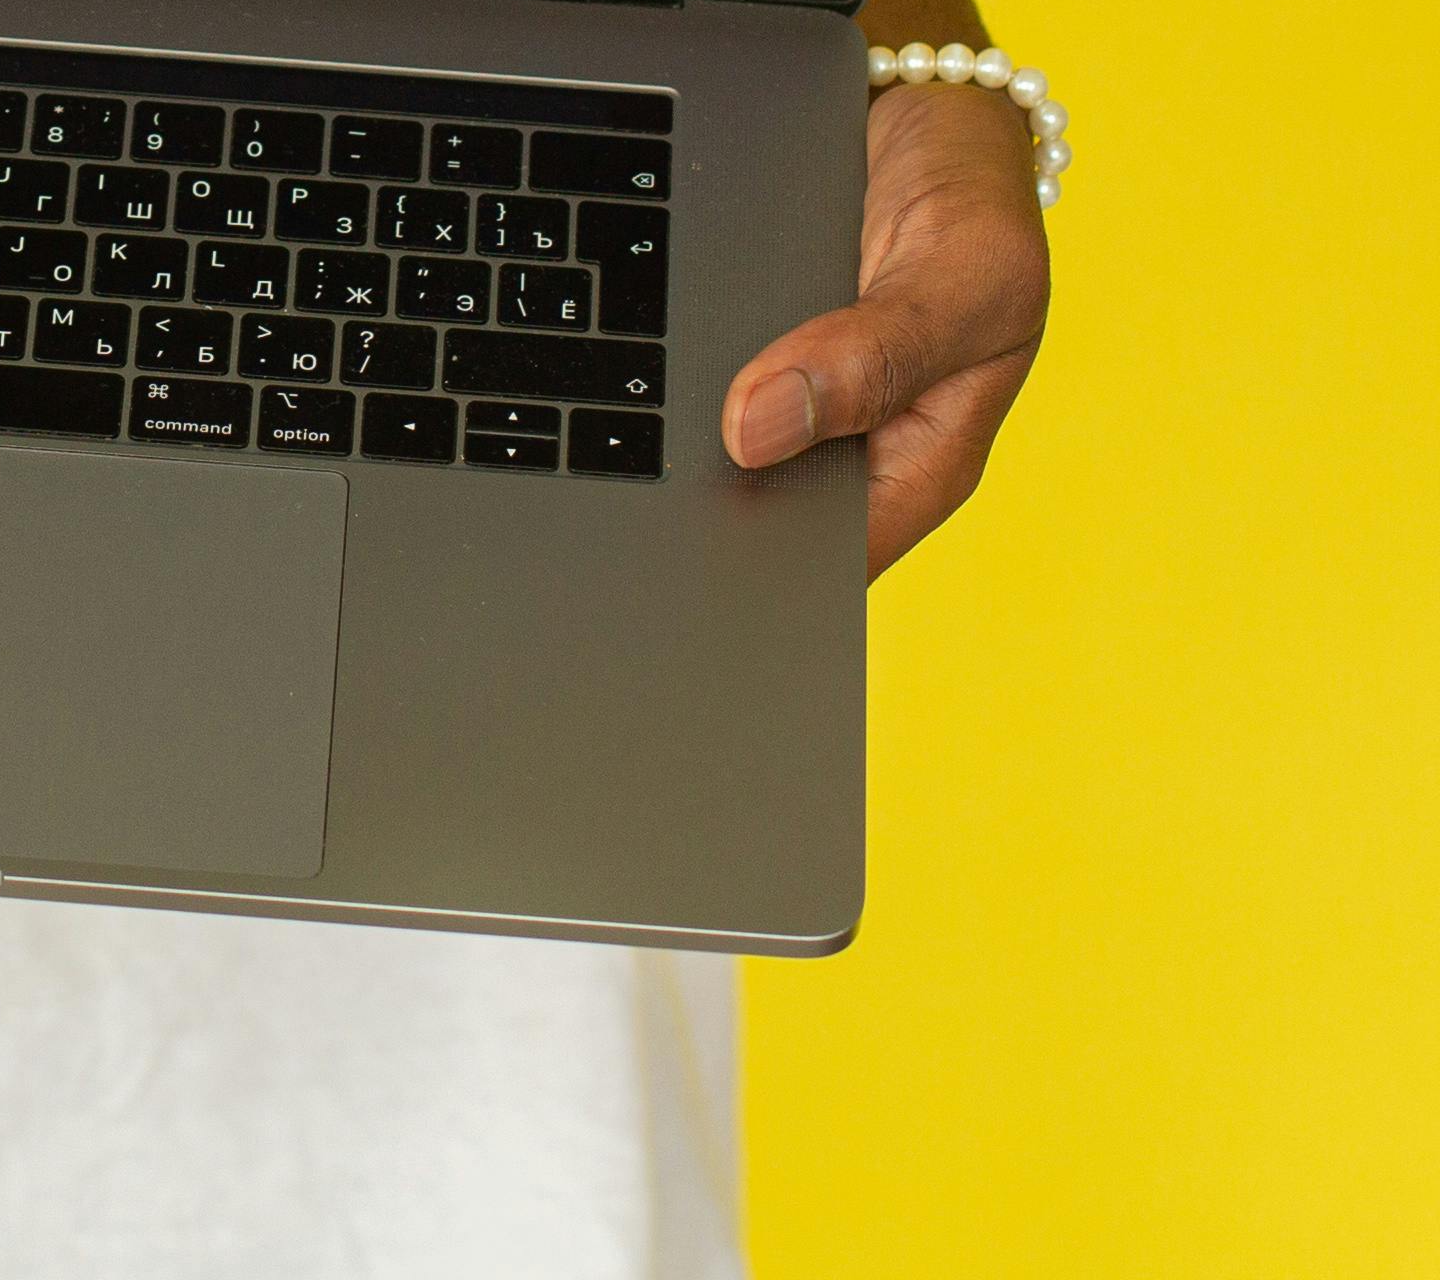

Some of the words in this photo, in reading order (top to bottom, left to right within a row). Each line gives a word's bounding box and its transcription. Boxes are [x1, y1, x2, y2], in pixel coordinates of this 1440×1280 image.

[48, 127, 63, 142] 8
[148, 134, 162, 149] 9
[247, 141, 262, 157] 0
[193, 181, 210, 197] O
[292, 188, 308, 203] P
[38, 196, 52, 211] Г
[127, 203, 152, 219] Ш
[227, 210, 254, 229] Щ
[337, 217, 352, 233] З
[11, 237, 24, 252] J
[533, 232, 552, 248] Ъ
[111, 243, 127, 260] K
[212, 251, 225, 267] L
[152, 273, 170, 289] Л
[253, 281, 273, 299] Д
[346, 287, 372, 304] Ж
[457, 295, 473, 312] Э
[562, 300, 575, 319] Ё
[52, 309, 73, 325] M
[97, 339, 112, 354] Ь
[199, 347, 214, 362] Б
[293, 354, 316, 370] Ю
[145, 420, 232, 434] command
[274, 429, 329, 441] option
